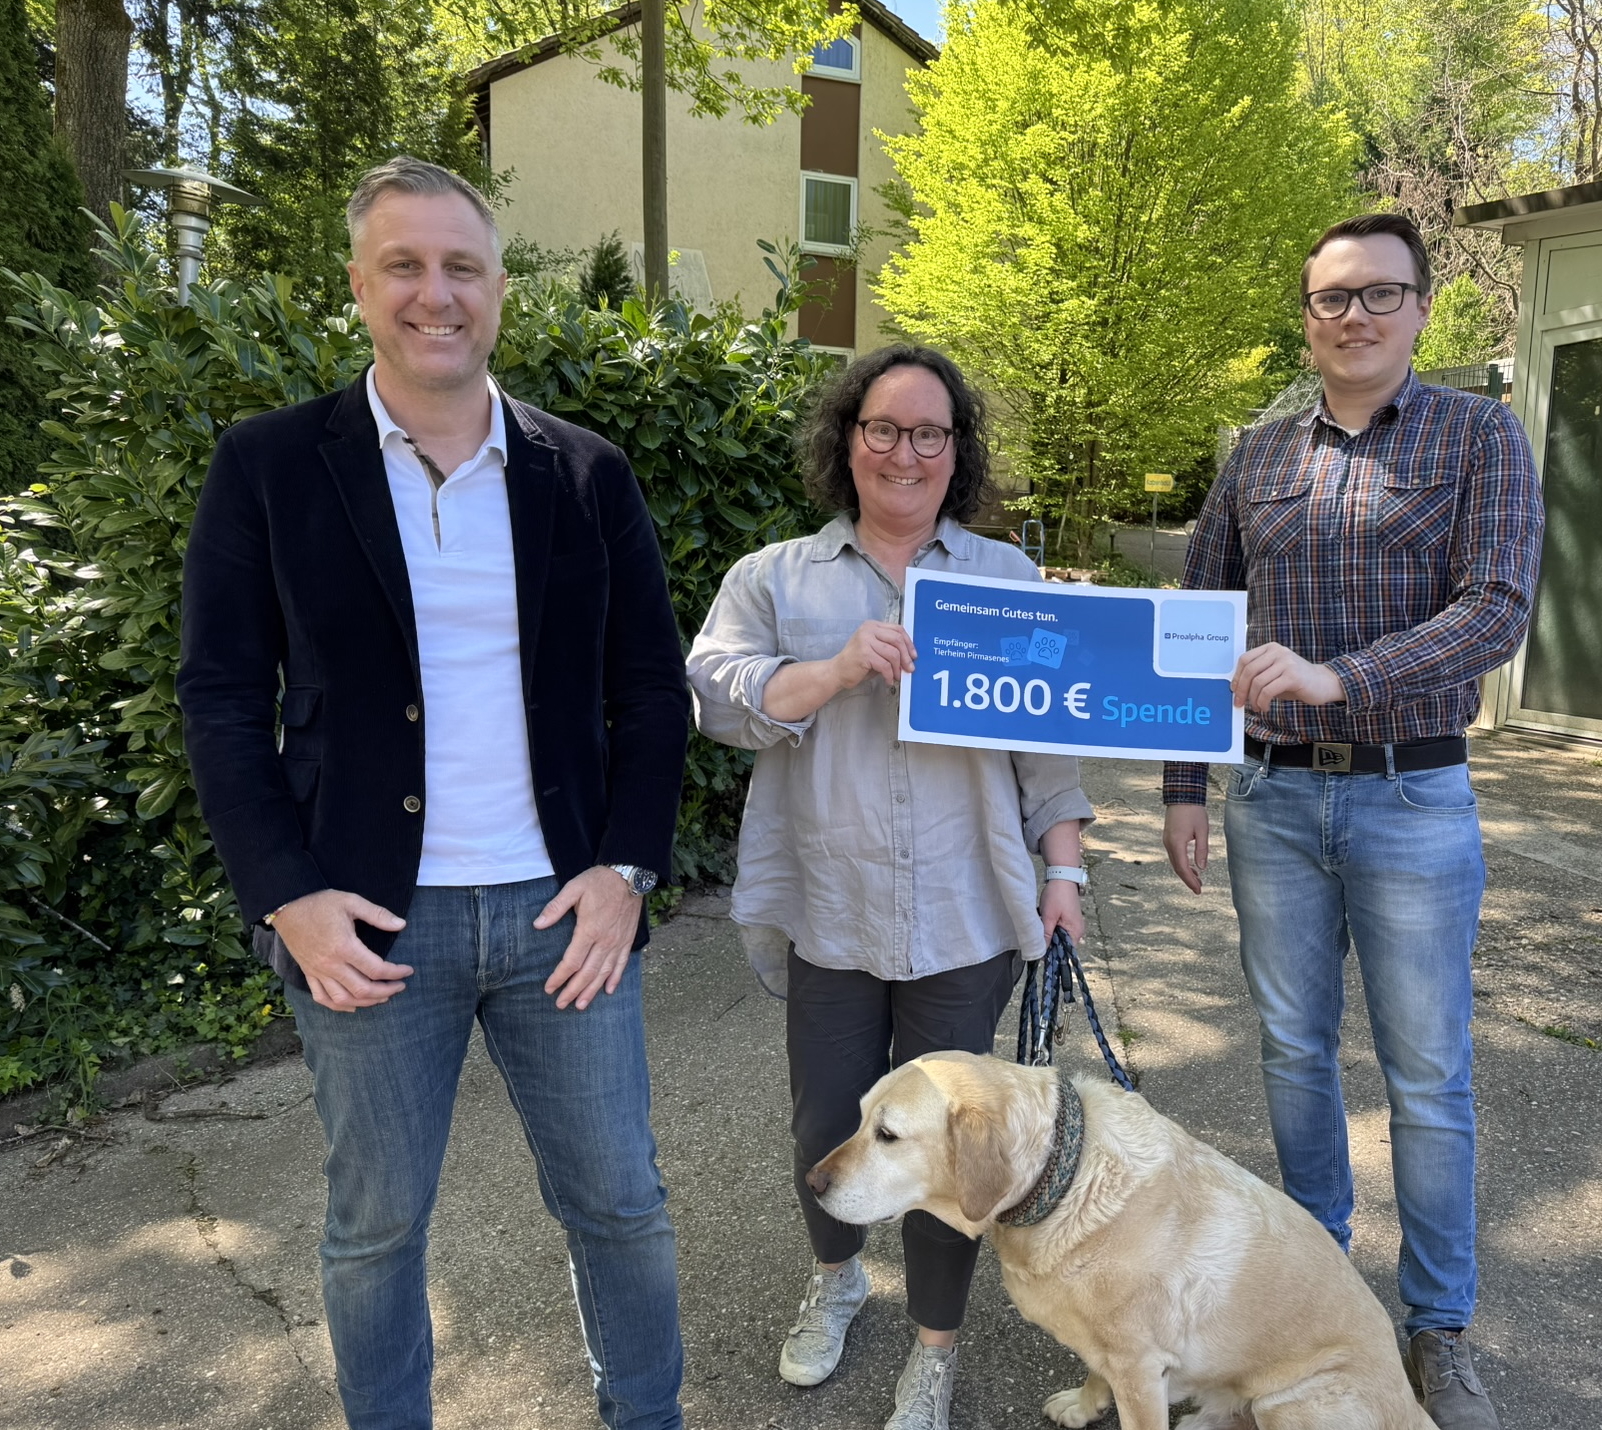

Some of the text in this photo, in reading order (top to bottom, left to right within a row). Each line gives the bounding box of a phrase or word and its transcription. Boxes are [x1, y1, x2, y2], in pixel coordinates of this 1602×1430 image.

[935, 599, 1059, 622] Gemeinsam Gutes tun.
[933, 637, 979, 650] Empfänger:
[1172, 632, 1230, 642] Proalpha Group
[933, 647, 1010, 663] Tierheim Pirmasenes
[932, 669, 1211, 728] 1.800 € Spende
